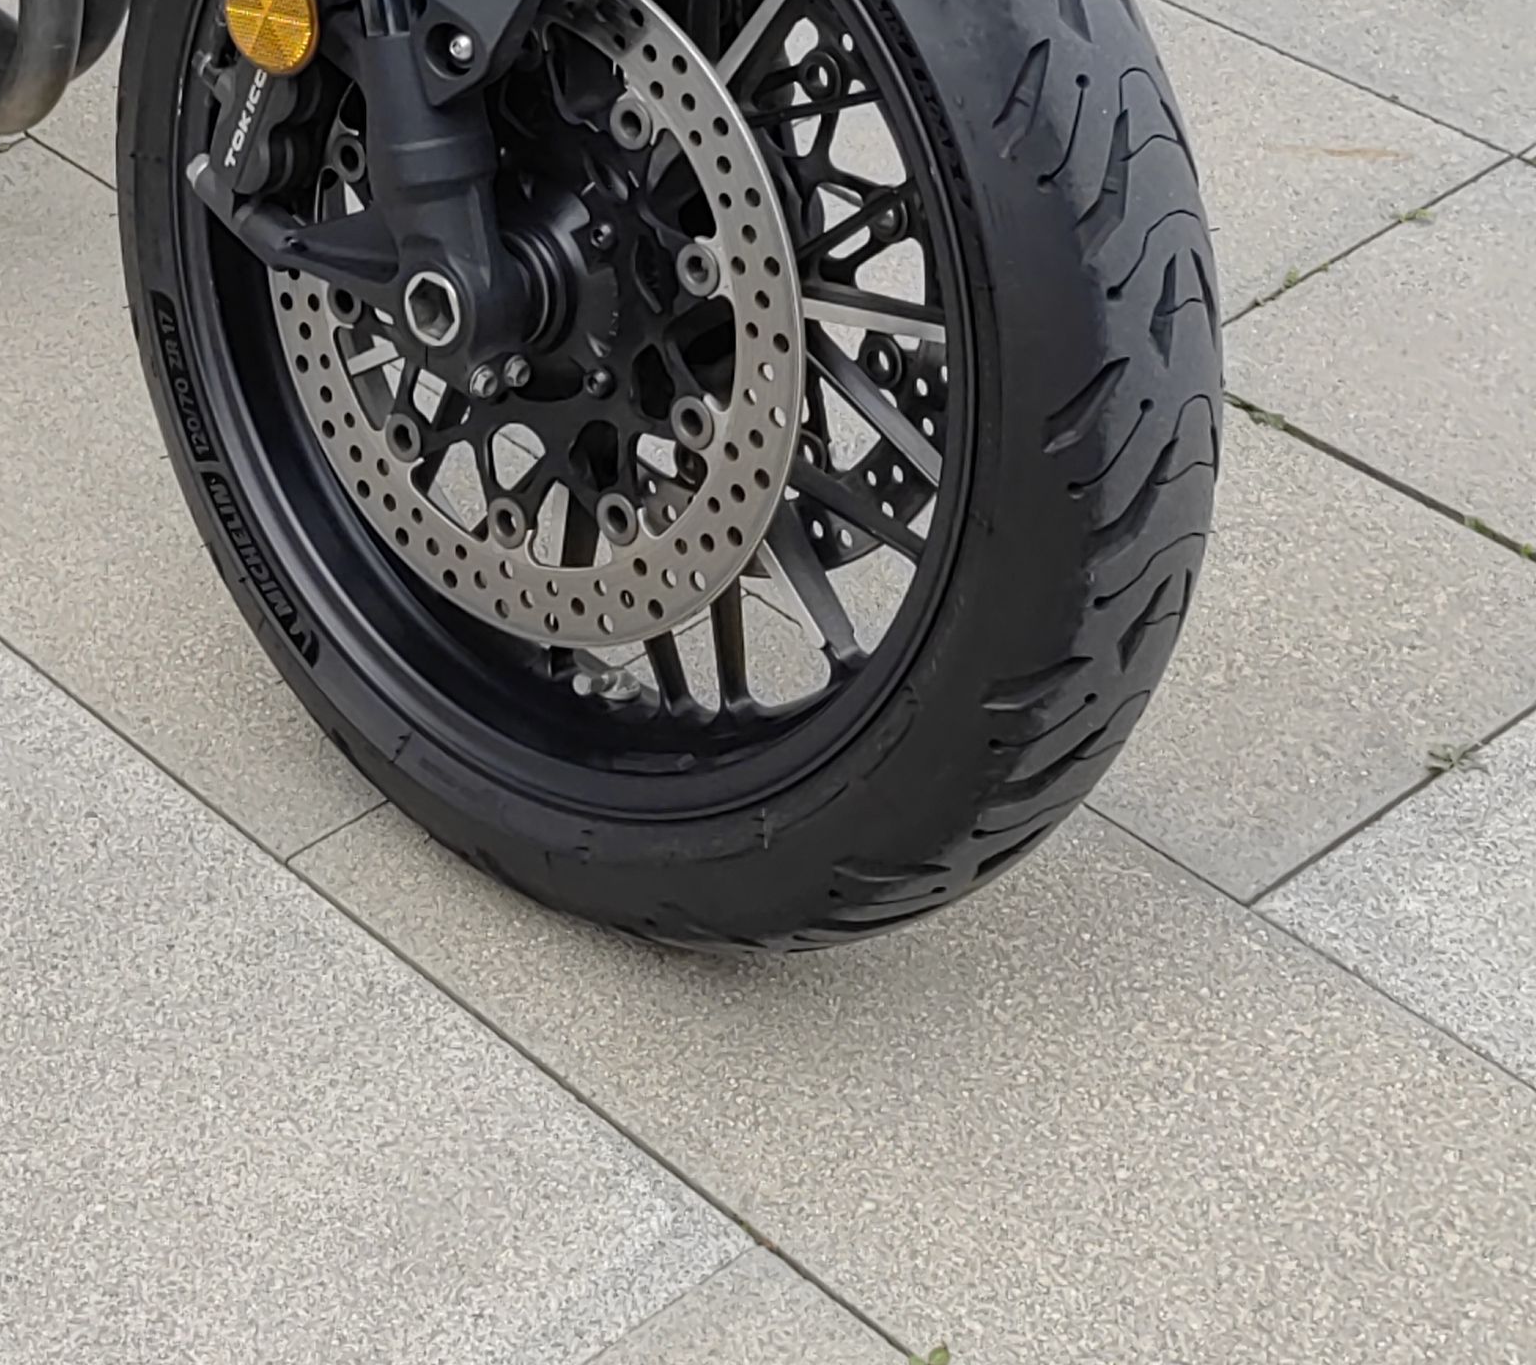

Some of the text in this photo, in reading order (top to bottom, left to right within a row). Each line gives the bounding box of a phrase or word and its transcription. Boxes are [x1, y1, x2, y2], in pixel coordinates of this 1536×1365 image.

[158, 310, 293, 617] MICHELIN 120/70 ZR 17
